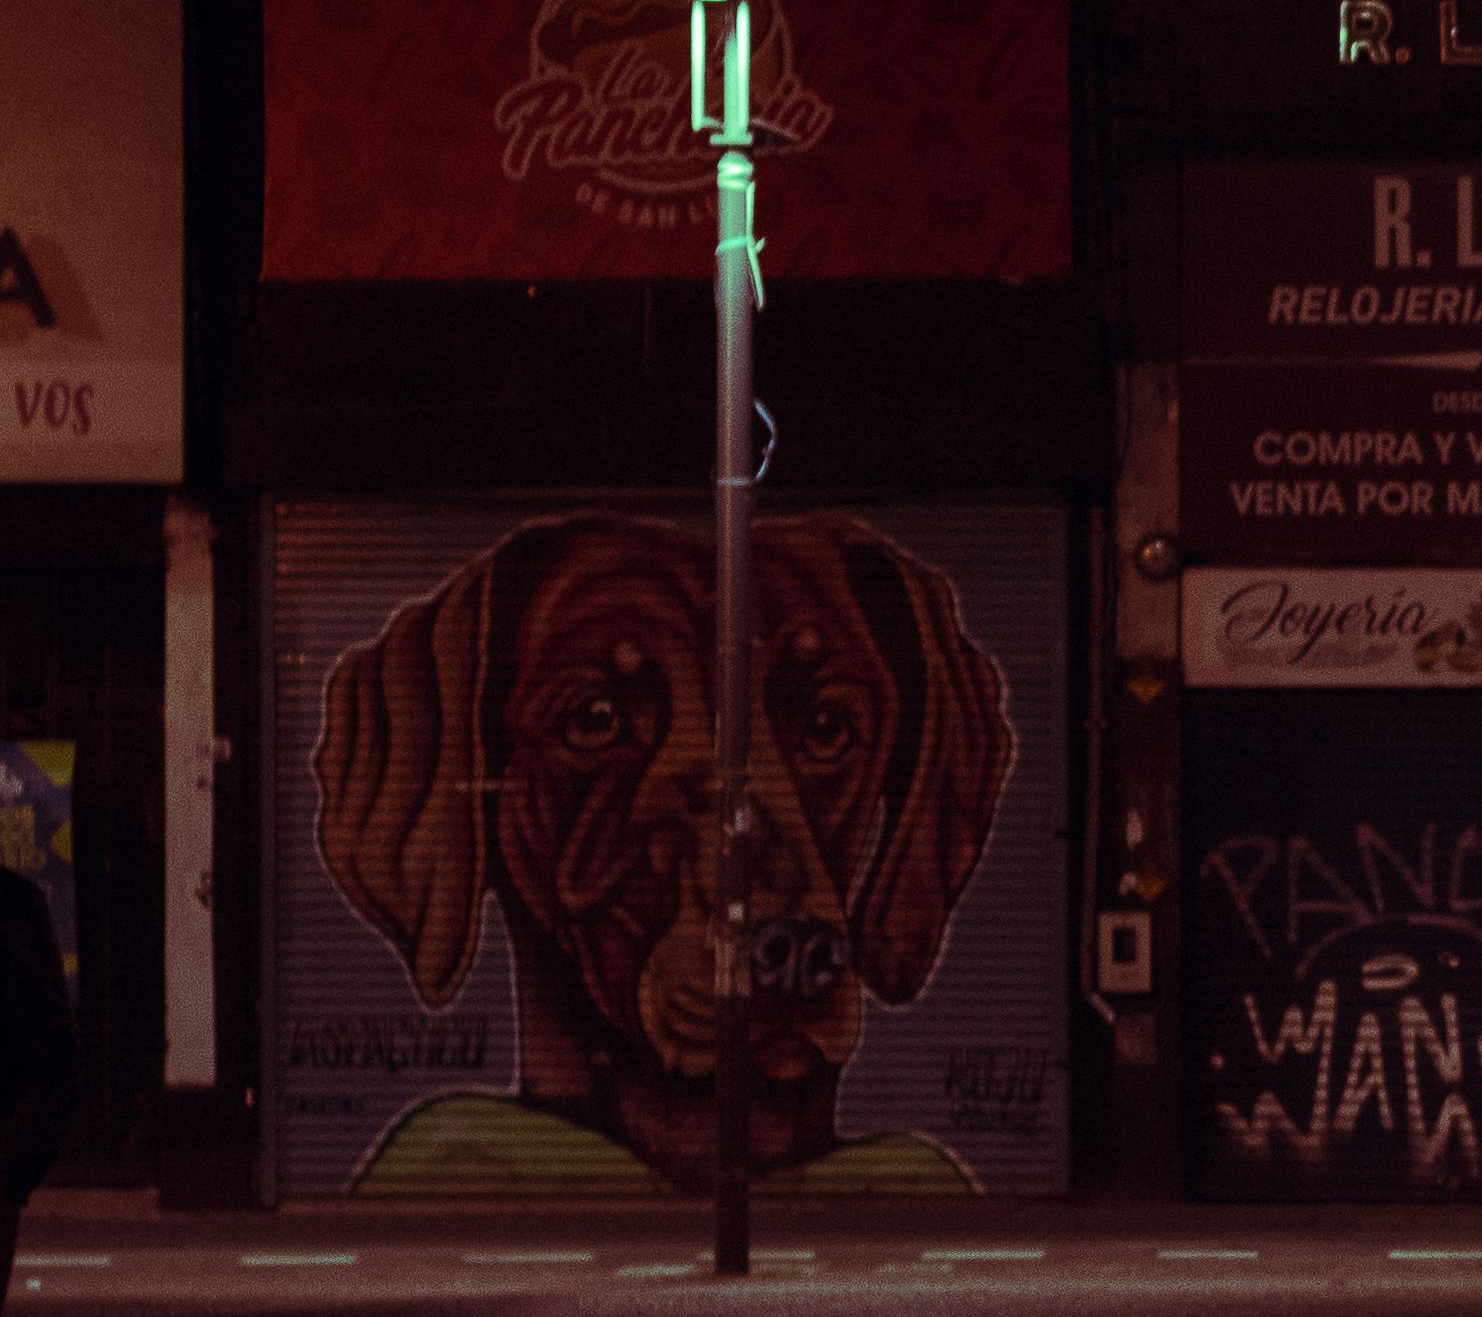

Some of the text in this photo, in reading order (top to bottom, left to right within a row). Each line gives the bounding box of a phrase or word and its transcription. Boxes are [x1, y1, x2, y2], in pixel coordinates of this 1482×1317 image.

[1373, 174, 1432, 268] R.
[14, 380, 94, 437] VOS
[1253, 430, 1424, 466] COMPRA
[1435, 430, 1461, 466] Y
[1229, 481, 1344, 517] VENTA
[1357, 481, 1435, 517] POR
